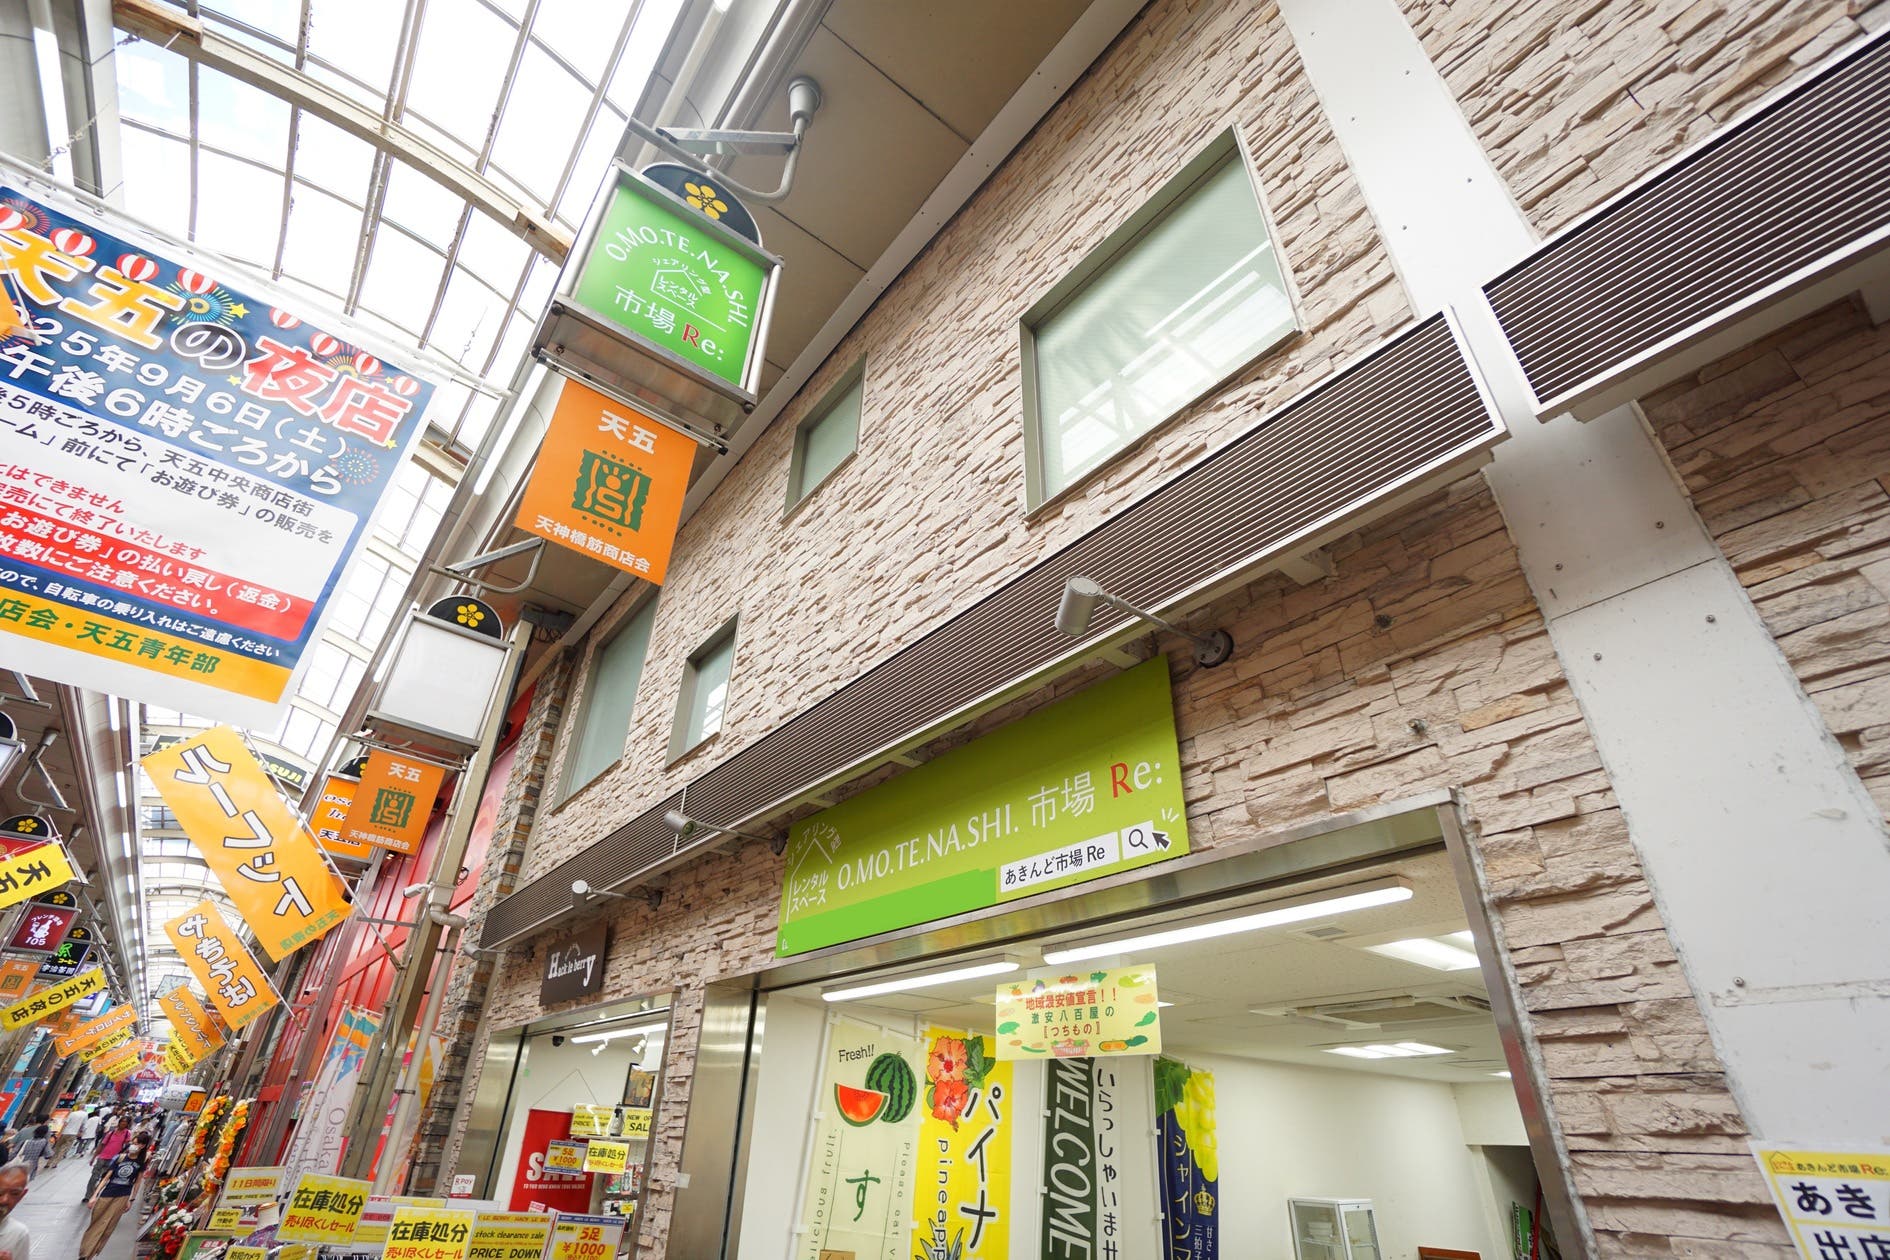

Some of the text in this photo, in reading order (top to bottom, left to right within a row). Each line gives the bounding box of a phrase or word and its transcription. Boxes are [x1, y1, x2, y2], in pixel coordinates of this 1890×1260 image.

[657, 282, 695, 309] スペース
[658, 275, 698, 300] レンタル
[0, 229, 413, 446] 天五の夜店
[615, 285, 723, 361] 市場 Re:
[14, 305, 347, 460] 25年9月6日（土）
[0, 344, 342, 496] 午後6時ごろから
[597, 409, 658, 454] 天五
[535, 515, 650, 573] 天神橋筋商店会
[0, 567, 280, 657] ので、自転車の乗り入れはご遠慮ください
[388, 762, 422, 782] 天五
[837, 760, 1163, 890] O.MO.TE.NA.SHI. 市場 Re:
[1004, 845, 1106, 886] あきんど市場 Re
[793, 870, 829, 895] レンタル
[790, 888, 826, 914] スペース
[25, 936, 46, 946] 105
[11, 977, 96, 1022] 天五の夜店
[1031, 1006, 1115, 1025] 激安八百屋の
[838, 1044, 875, 1063] Fresh!!
[318, 1107, 346, 1169] Osaka
[589, 1147, 626, 1161] 在庫処分
[960, 1086, 1002, 1250] パイナ
[1049, 1057, 1091, 1260] WELCOME
[293, 1187, 364, 1216] 在庫処分
[845, 1169, 881, 1222] す
[1791, 1182, 1876, 1219] あき
[285, 1214, 356, 1233] 売り尽くしセール
[392, 1221, 469, 1243] 在庫処分
[579, 1226, 600, 1241] 5足
[386, 1246, 463, 1260] 売り尽くしセール
[469, 1247, 542, 1259] PRICE DOWN
[562, 1242, 606, 1256] ¥1000
